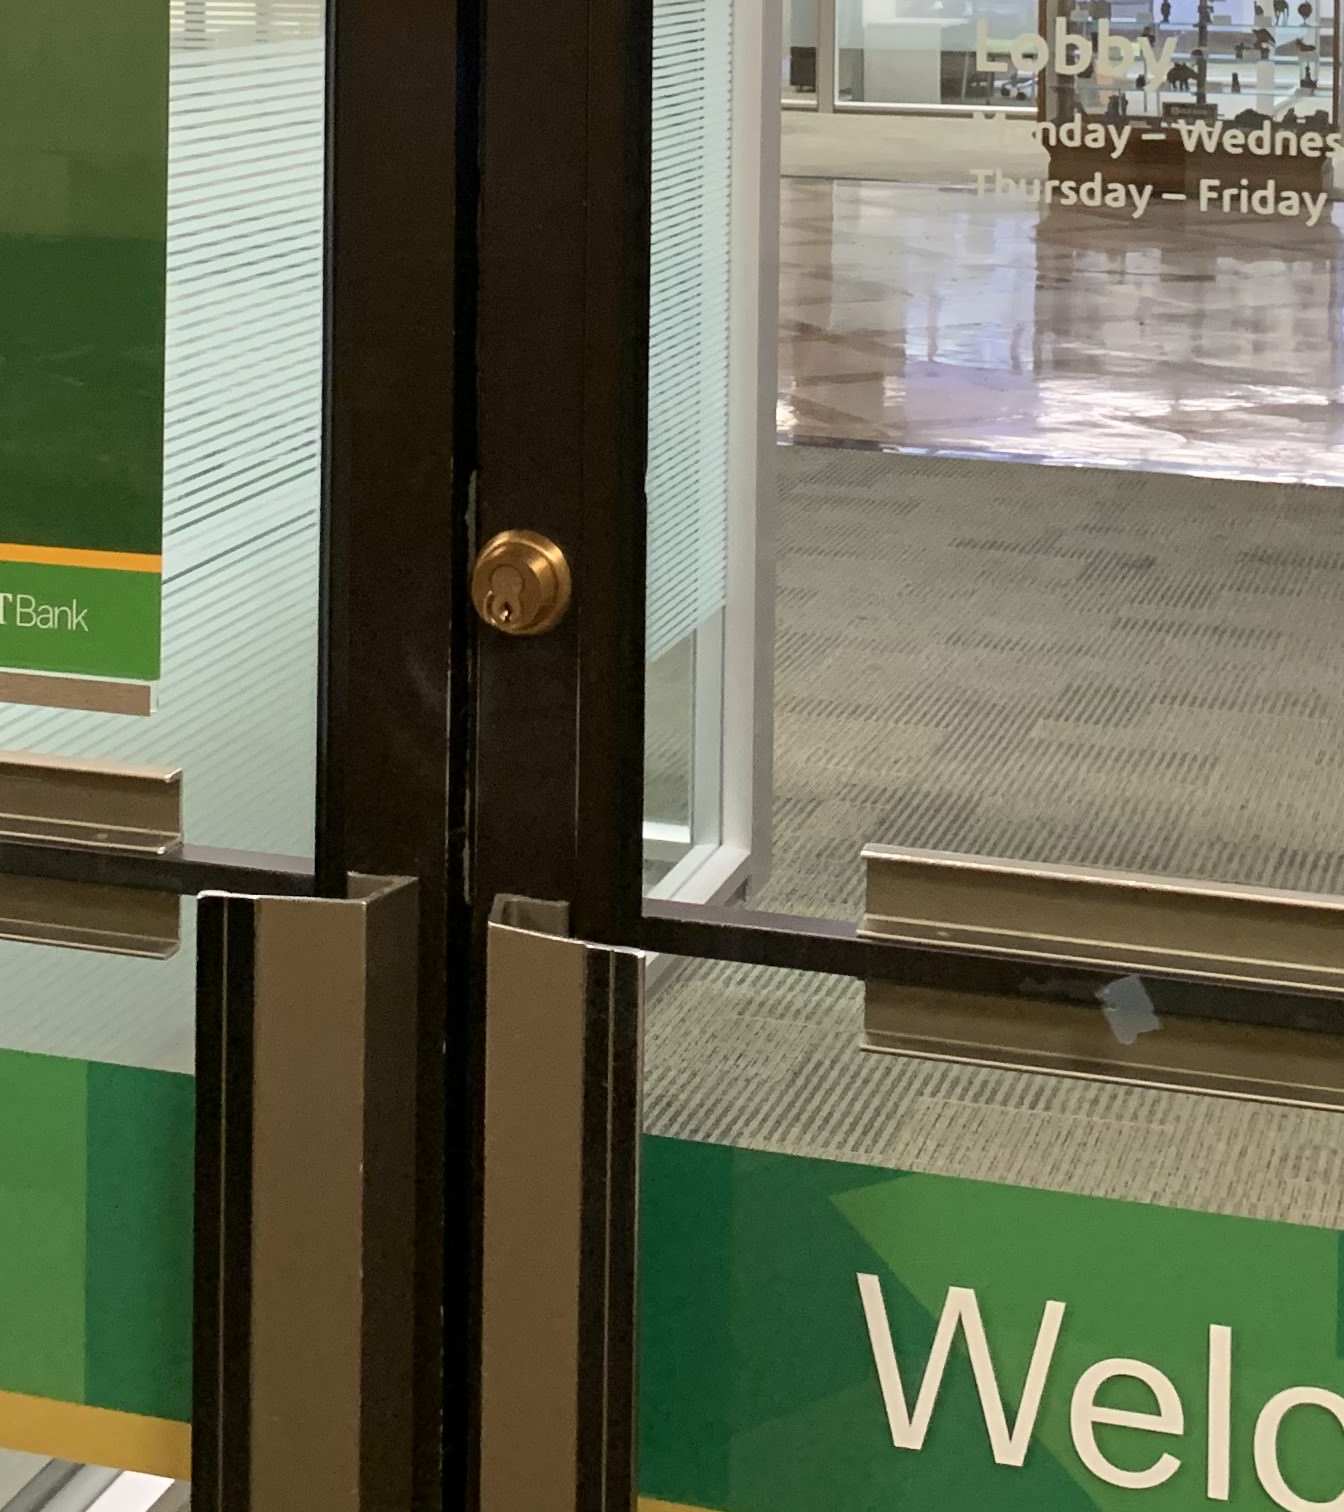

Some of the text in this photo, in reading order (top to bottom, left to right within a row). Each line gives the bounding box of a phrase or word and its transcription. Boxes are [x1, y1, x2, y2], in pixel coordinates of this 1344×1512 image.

[976, 17, 1178, 90] Lobby
[972, 111, 1132, 159] nday
[969, 169, 1153, 218] Thursday
[1199, 179, 1327, 227] Friday
[16, 594, 88, 631] Bank
